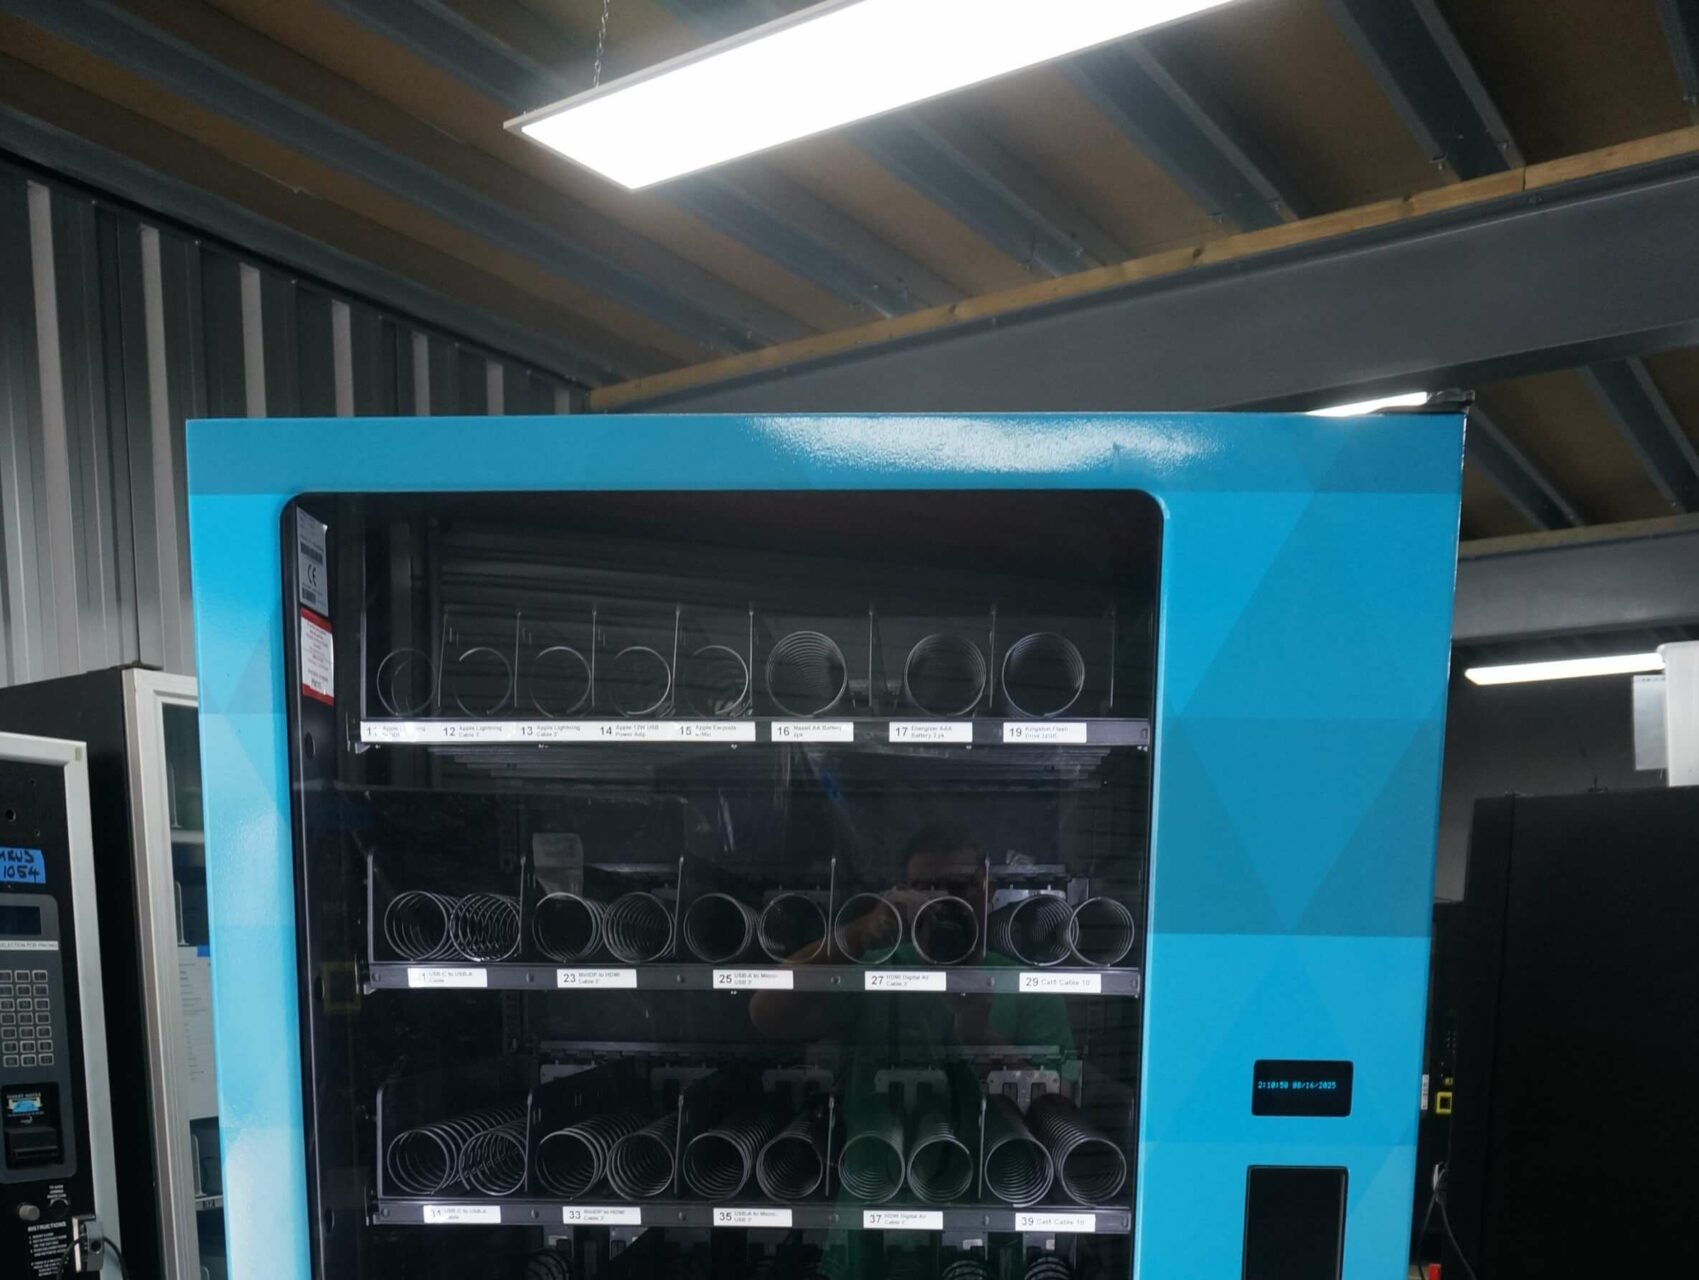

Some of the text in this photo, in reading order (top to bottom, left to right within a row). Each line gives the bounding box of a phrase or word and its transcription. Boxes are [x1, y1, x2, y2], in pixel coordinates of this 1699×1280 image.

[443, 727, 456, 737] 12
[521, 727, 533, 736] 13
[536, 725, 580, 733] Apple Lightning
[600, 726, 613, 736] 14
[680, 727, 692, 736] 15
[777, 726, 790, 736] 16
[895, 727, 908, 737] 17
[1009, 727, 1022, 737] 19
[3, 865, 40, 884] 1054
[563, 973, 576, 983] 23
[719, 974, 732, 984] 25
[872, 975, 884, 985] 27
[1025, 977, 1039, 987] 29
[569, 1210, 581, 1220] 33
[719, 1211, 732, 1221] 35
[869, 1214, 882, 1224] 37
[1021, 1216, 1034, 1226] 39
